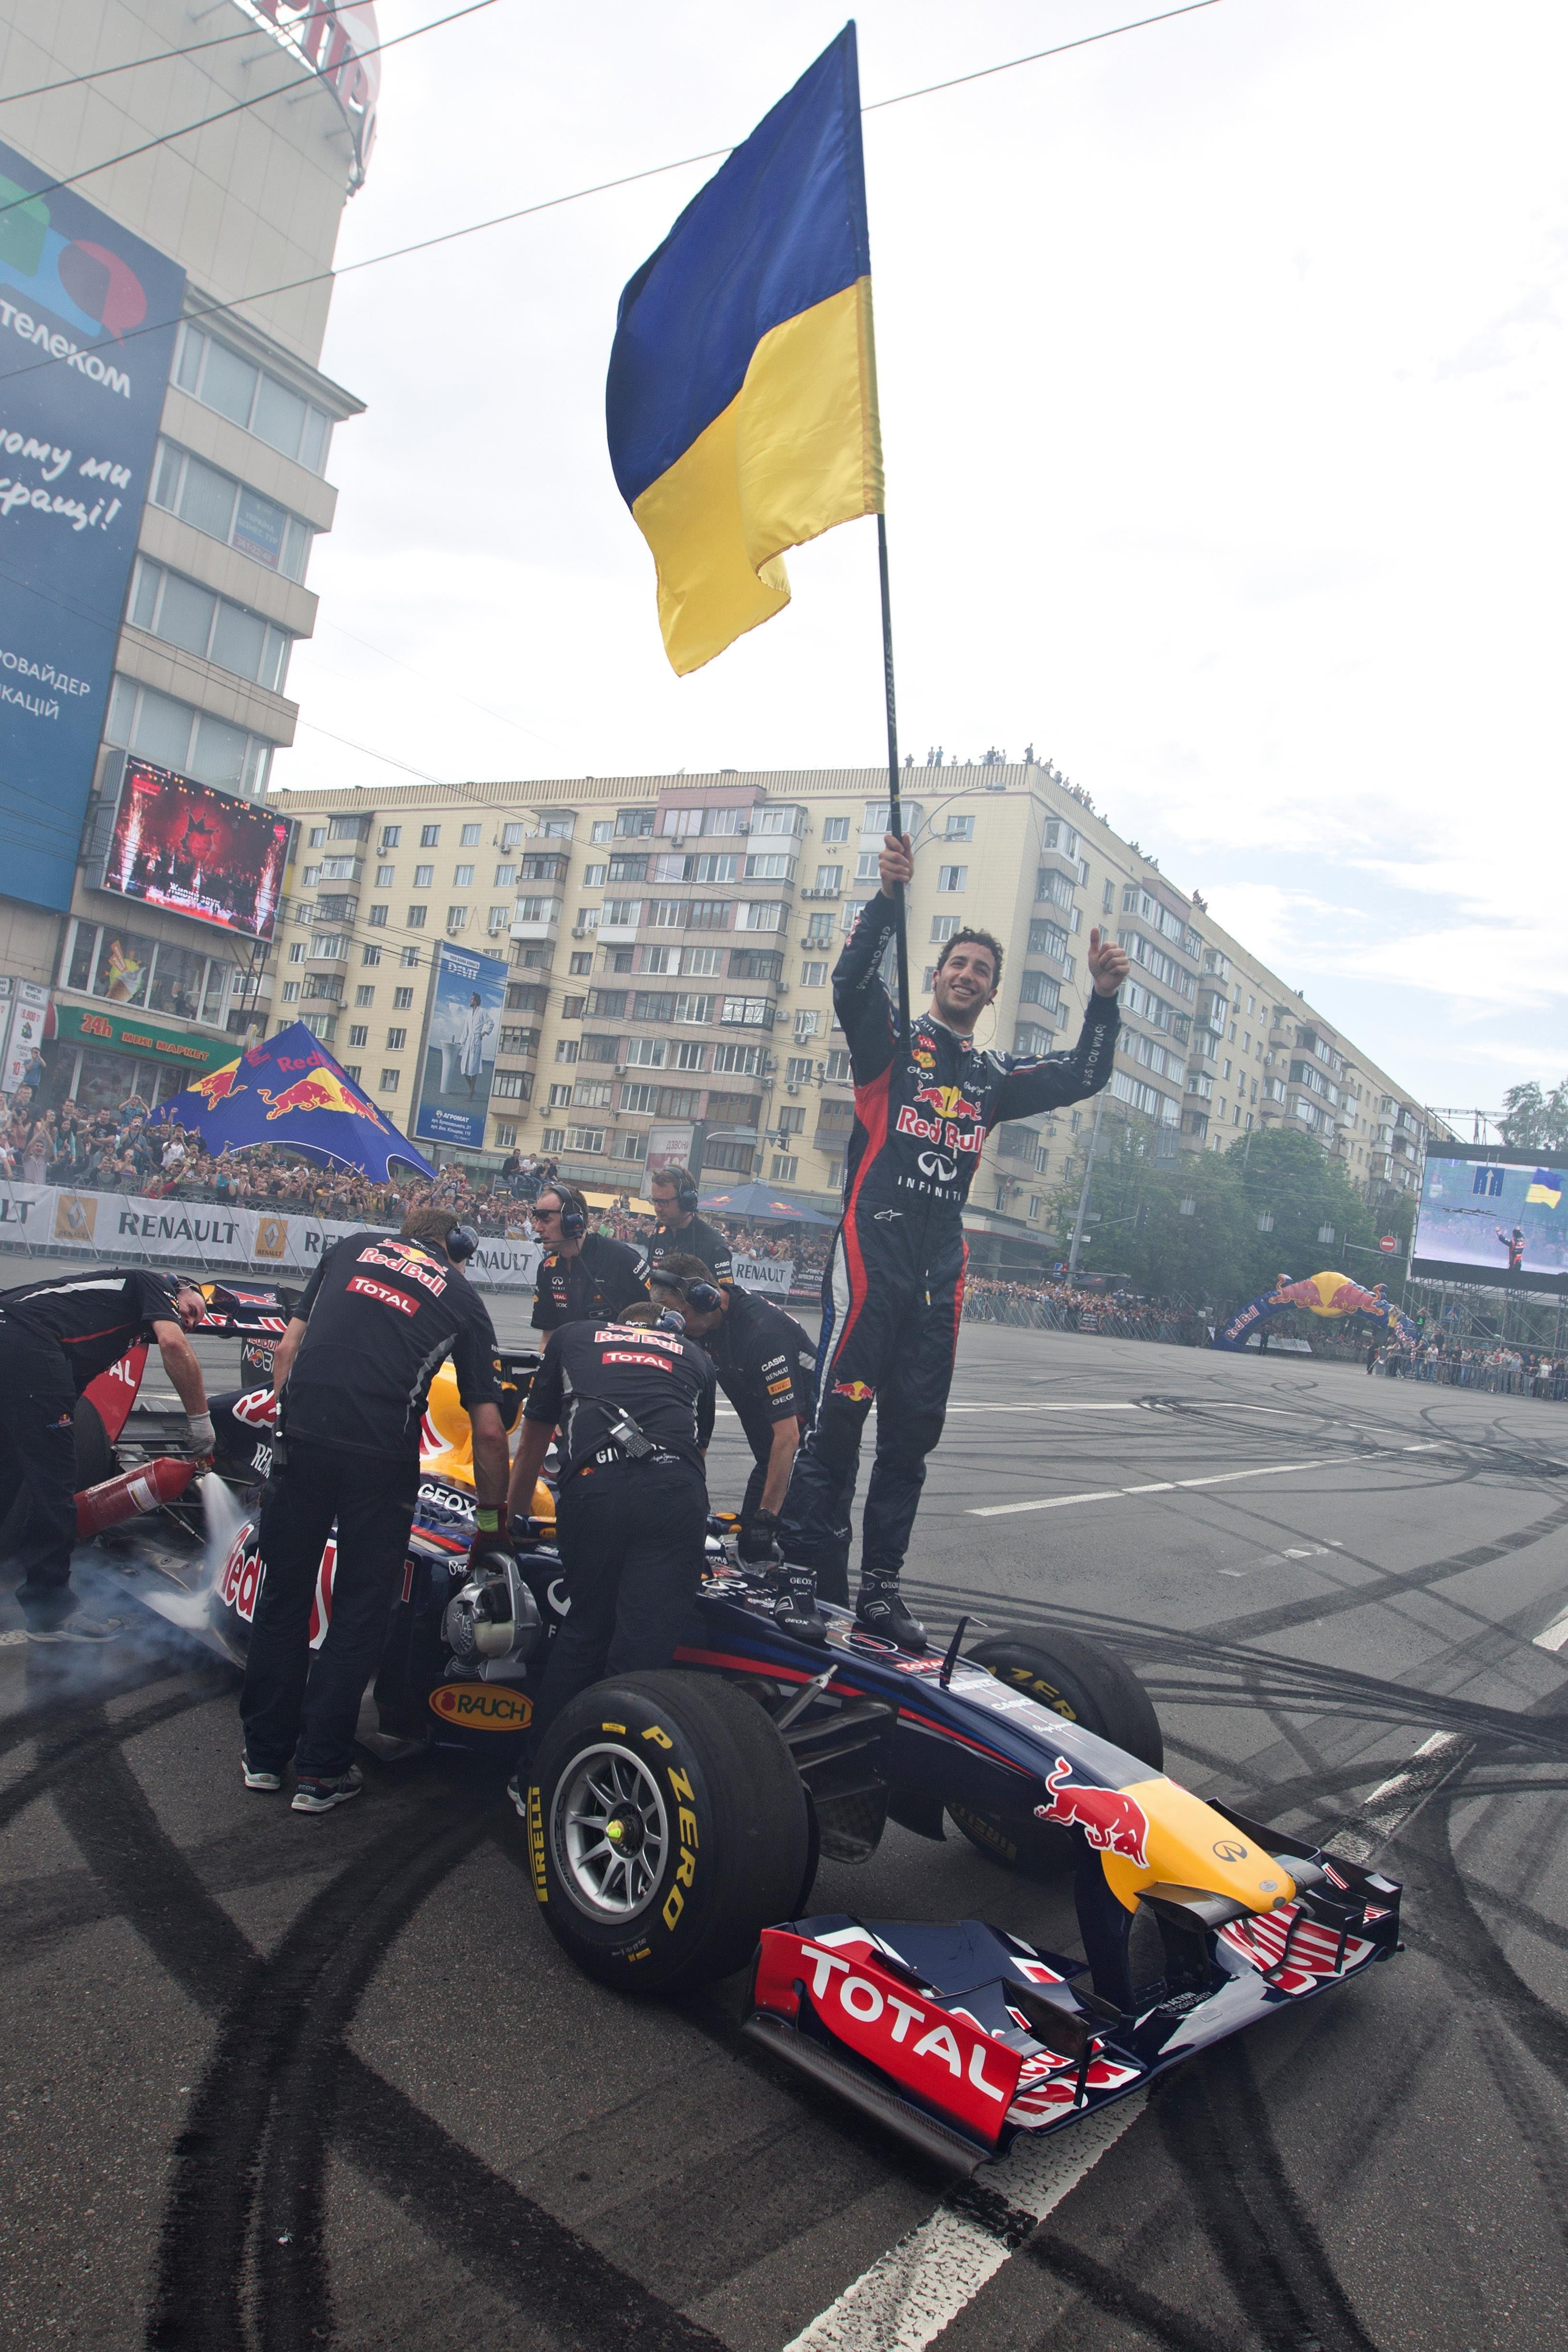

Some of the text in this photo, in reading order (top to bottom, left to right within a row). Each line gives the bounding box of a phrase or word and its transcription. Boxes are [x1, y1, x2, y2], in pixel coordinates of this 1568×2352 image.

[0, 650, 91, 697] ОВАЙДЕР
[0, 684, 59, 720] КАЦІЙ
[81, 1013, 112, 1038] 24h
[122, 1033, 209, 1061] МІНІ МАРКЕТ
[277, 1050, 321, 1073] Red
[443, 1113, 469, 1123] АГРОМАТ
[896, 1105, 986, 1152] Red Bull
[118, 1212, 240, 1244] RENAULT
[356, 1248, 447, 1297] Red Bull
[736, 1263, 786, 1283] RENAULT
[355, 1278, 412, 1313] TOTAL
[1225, 1305, 1260, 1340] Red Bull
[594, 1331, 684, 1355] Red Bull
[607, 1352, 669, 1370] TOTAL
[761, 1355, 786, 1372] CASIO
[772, 1392, 795, 1406] GEOX
[417, 1483, 476, 1521] GEOX
[790, 1576, 812, 1586] GEOX
[785, 1617, 809, 1626] GEOX
[896, 1660, 944, 1672] TOTA
[458, 1695, 525, 1721] RAUCH
[991, 1698, 1034, 1711] CASIO
[641, 1725, 698, 1931] P ZERO
[528, 1787, 549, 1902] PIRELLI
[1167, 1991, 1197, 2006] ACTION
[801, 1945, 1004, 2102] TOTAL
